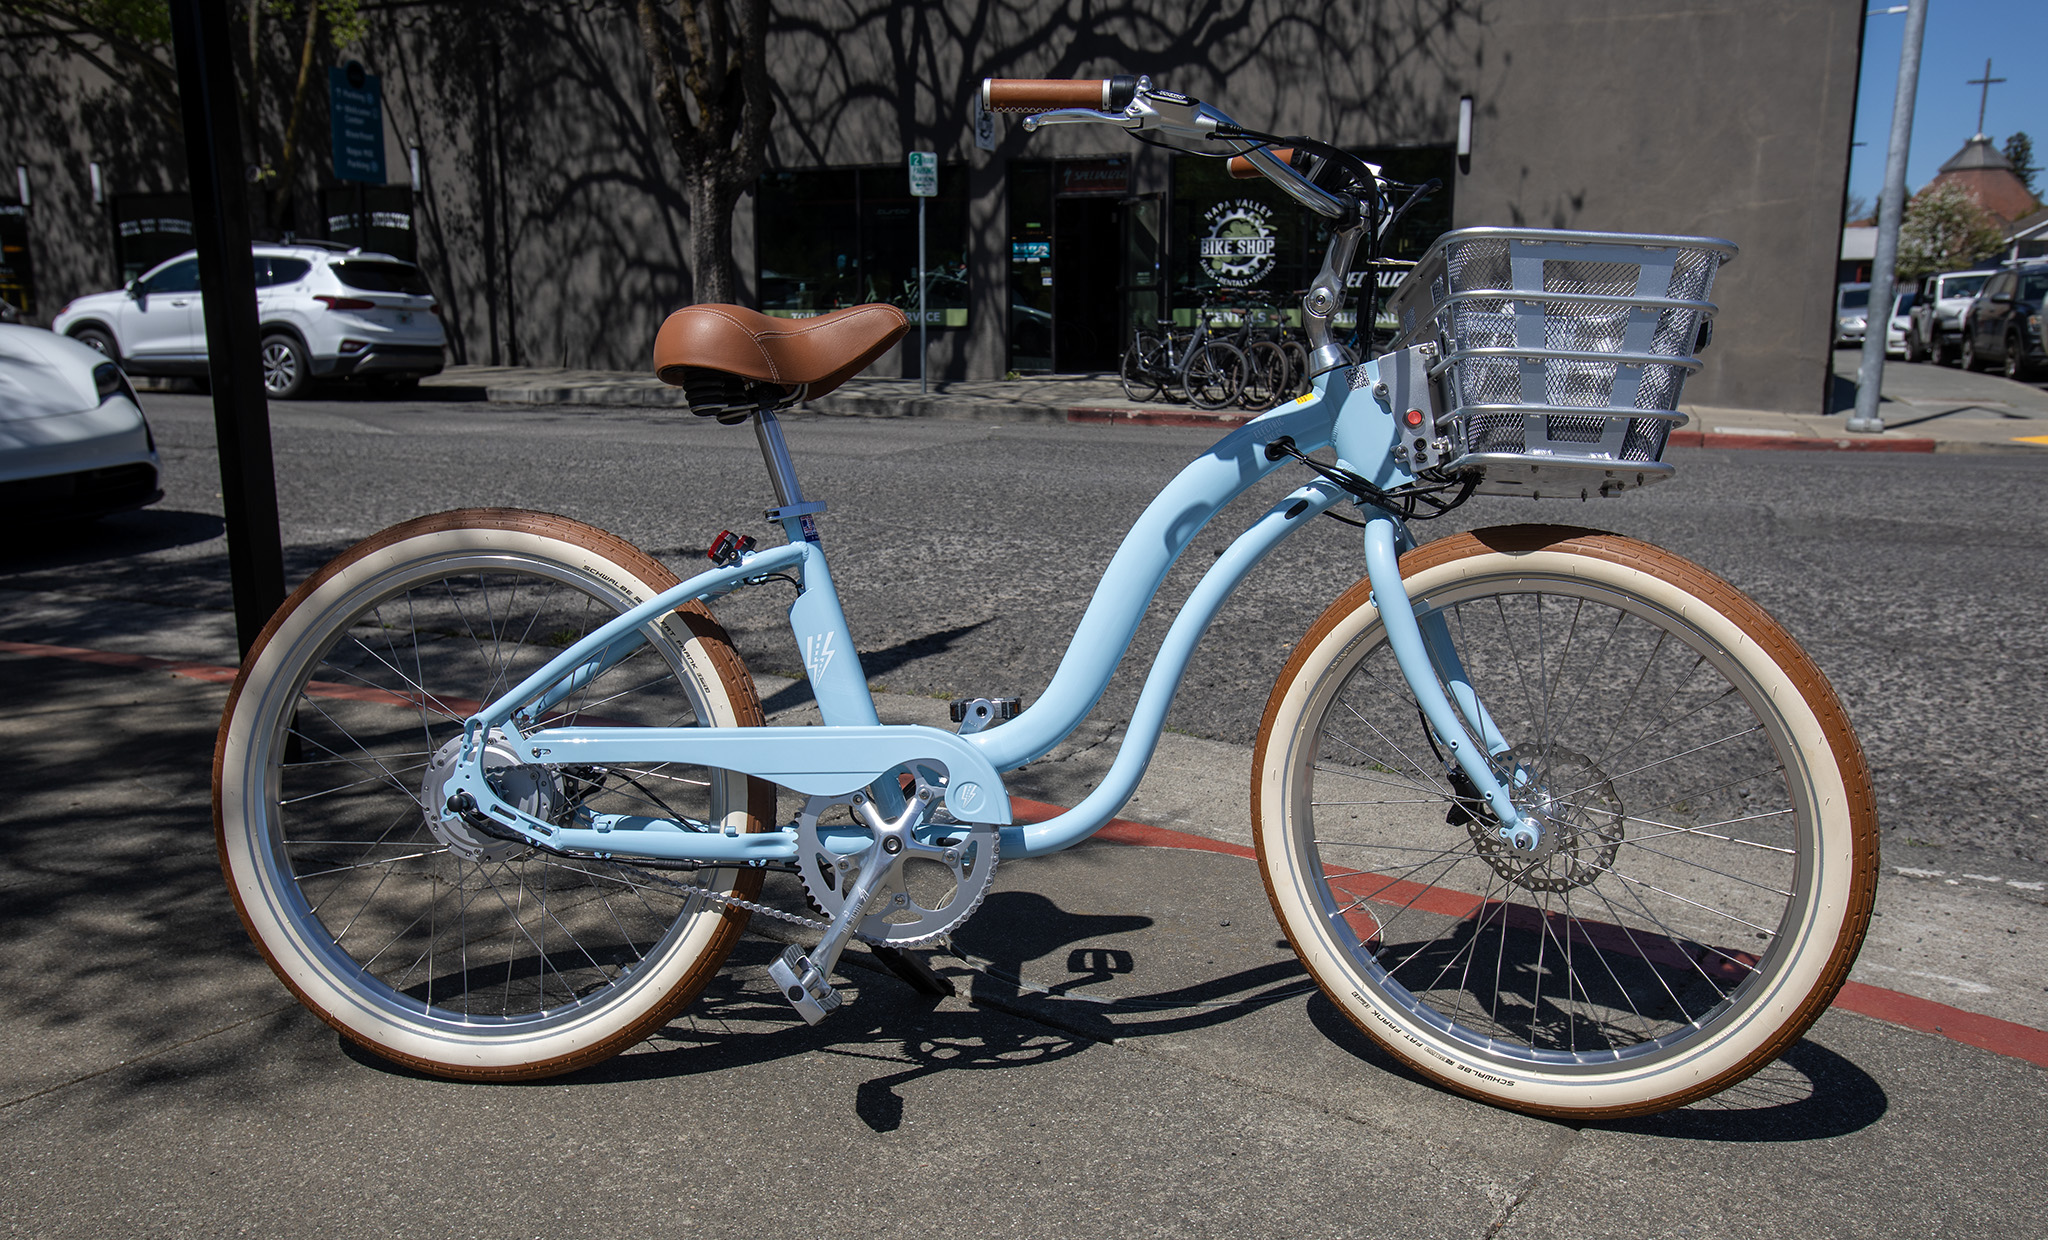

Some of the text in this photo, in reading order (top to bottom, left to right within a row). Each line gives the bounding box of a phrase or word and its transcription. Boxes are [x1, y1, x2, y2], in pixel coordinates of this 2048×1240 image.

[1203, 198, 1274, 221] NAPA VALLEY
[1201, 239, 1275, 255] BIKE SHOP
[1199, 258, 1276, 287] SALES RENTALS SERVICE
[582, 565, 633, 596] SCHWALBE
[661, 621, 698, 670] FAT FRANK
[1370, 1009, 1402, 1034] FRANK
[1403, 1034, 1424, 1047] FAT
[1457, 1064, 1516, 1087] SCHWALBE
